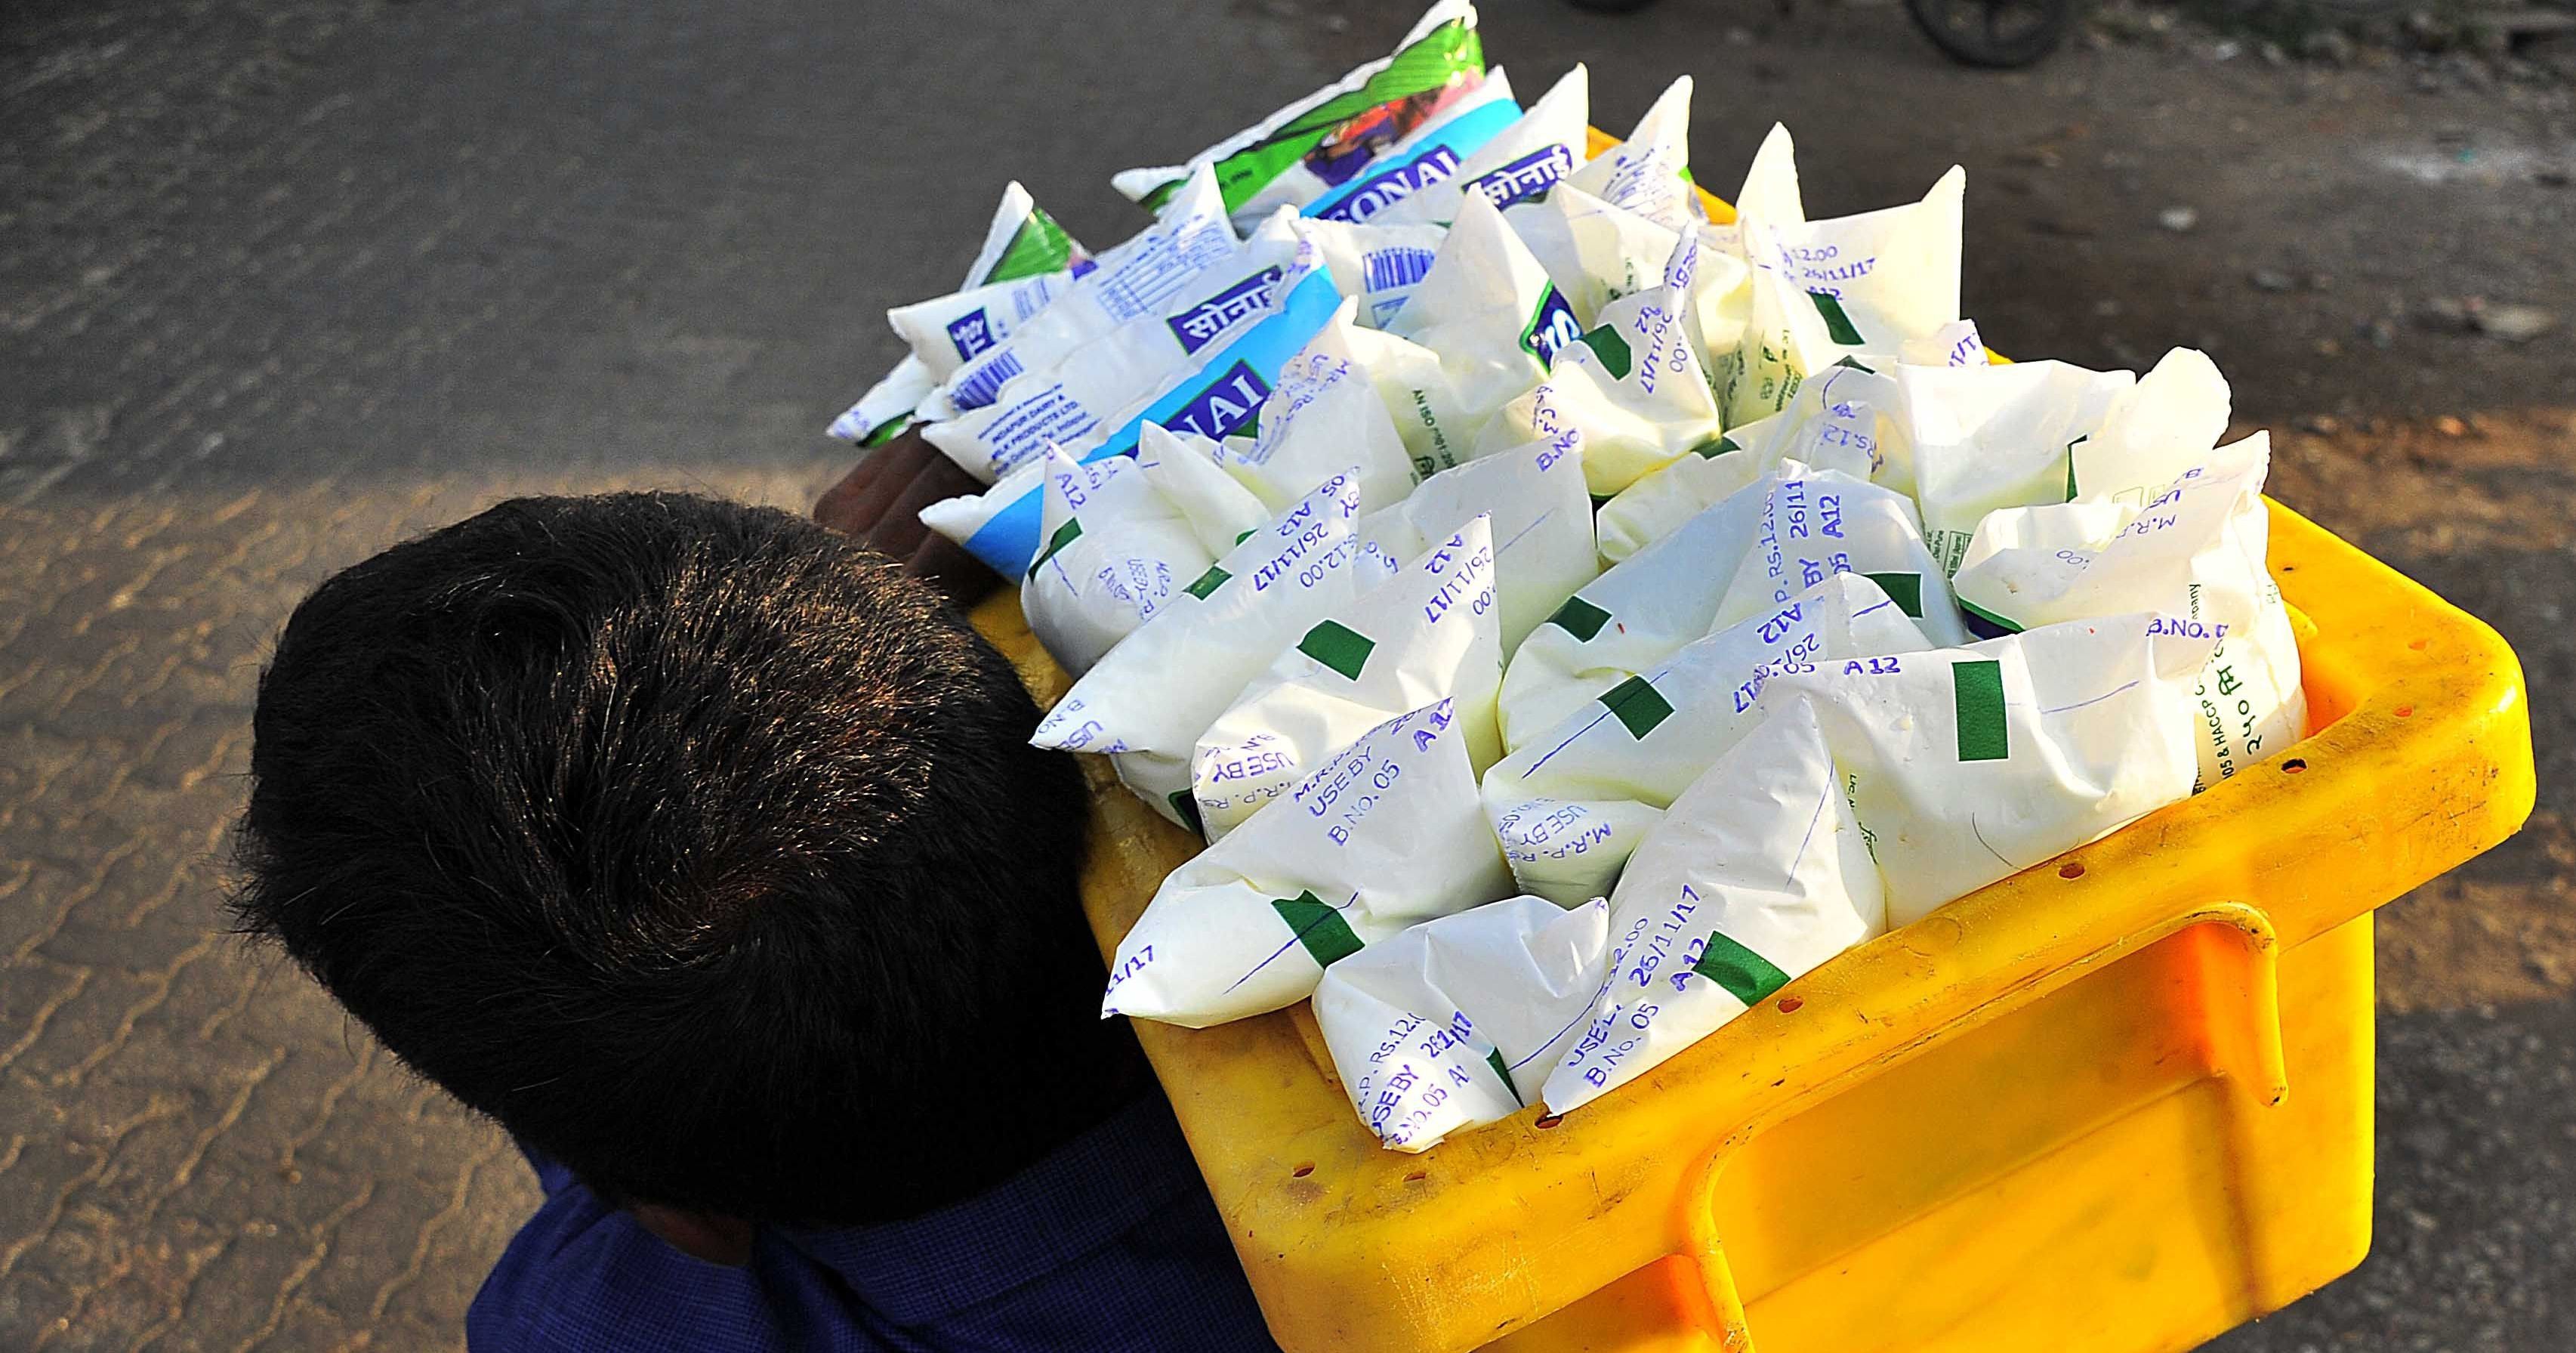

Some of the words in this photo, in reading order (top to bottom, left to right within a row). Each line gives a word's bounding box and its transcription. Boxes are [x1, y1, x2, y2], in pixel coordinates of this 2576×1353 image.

[1055, 473, 1087, 510] A12
[1276, 502, 1311, 536] A12
[1819, 494, 1845, 539] A12
[1254, 523, 1328, 592] 26/11/17
[1425, 533, 1463, 574] A12
[1425, 546, 1492, 623] 26/11/17
[1757, 602, 1803, 644] A12
[1843, 656, 1901, 676] A12
[2201, 700, 2227, 746] HACCP
[1629, 885, 1700, 987] 26/11/17
[1670, 938, 1711, 992] A12
